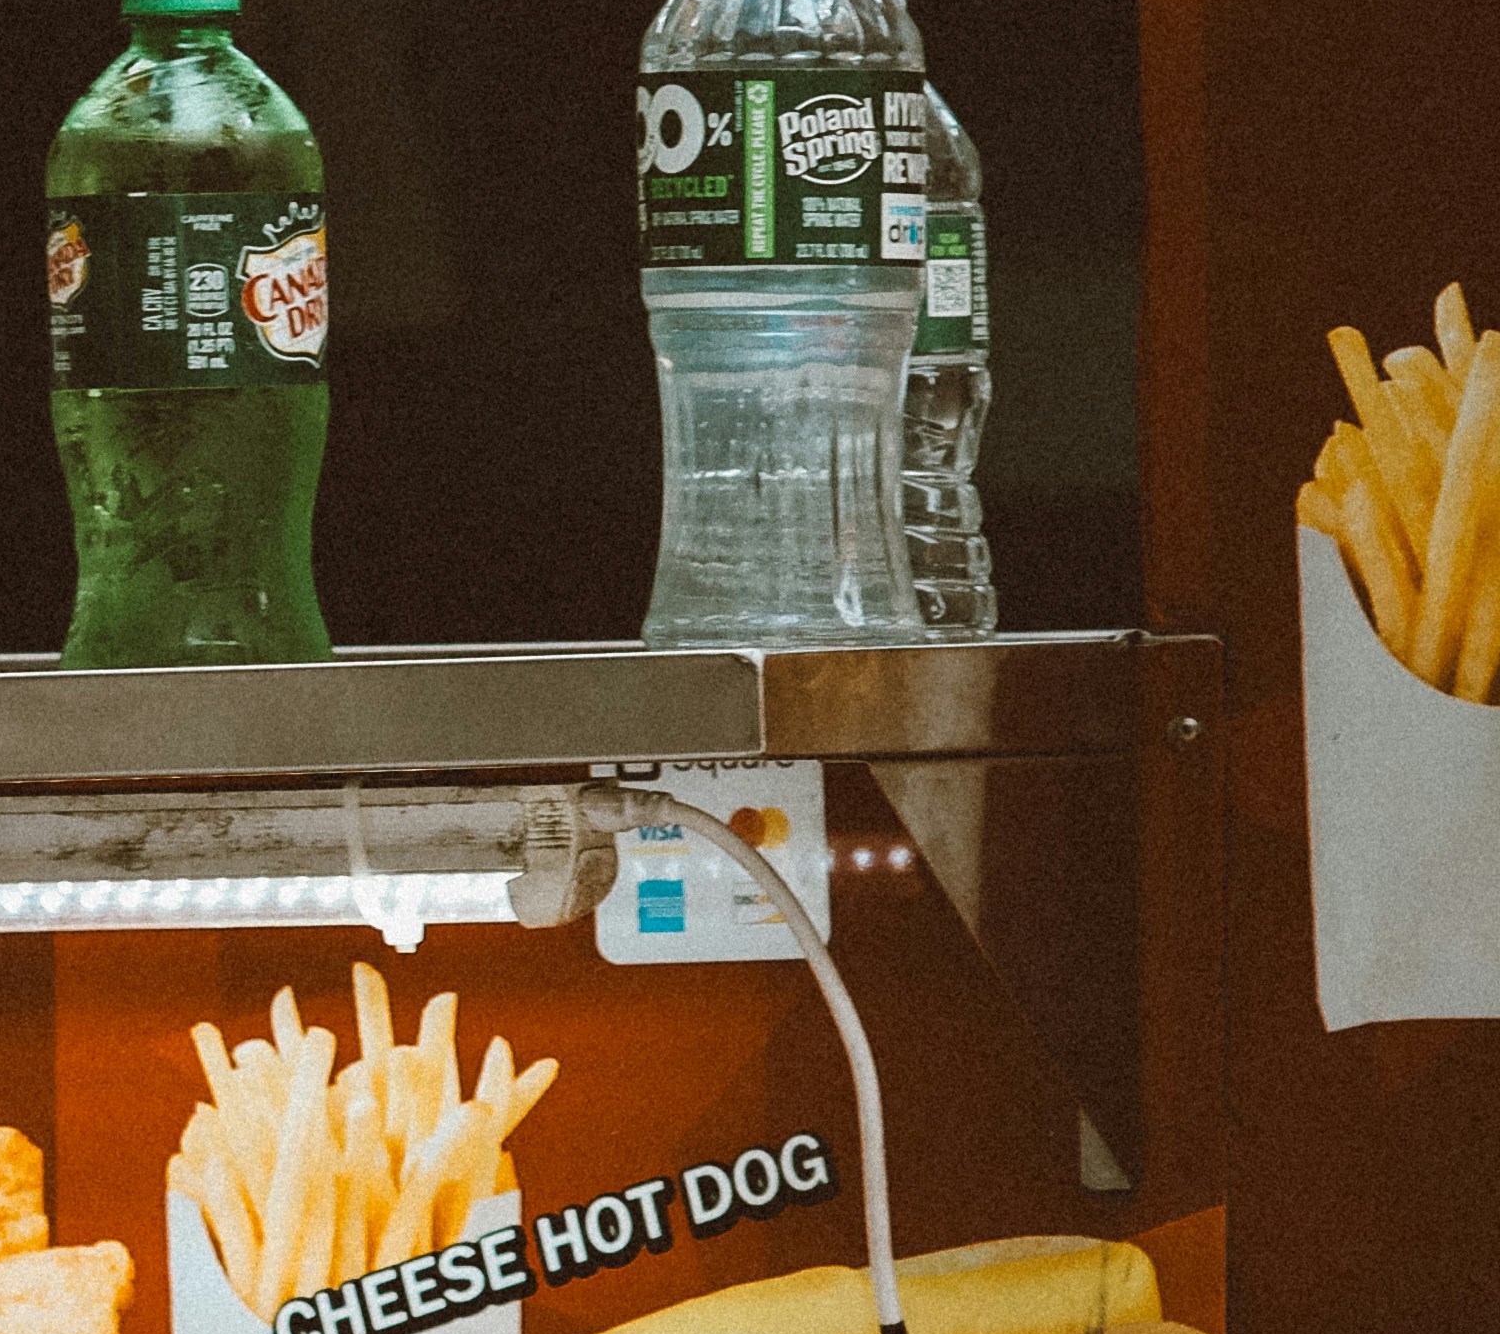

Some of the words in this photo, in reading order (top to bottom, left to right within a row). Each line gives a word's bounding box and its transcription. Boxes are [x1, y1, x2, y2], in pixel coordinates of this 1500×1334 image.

[778, 97, 875, 146] Poland
[782, 129, 880, 177] Spring
[188, 270, 226, 291] 230
[638, 823, 684, 842] VISA
[534, 1181, 666, 1273] HOT
[681, 1134, 830, 1225] DOG
